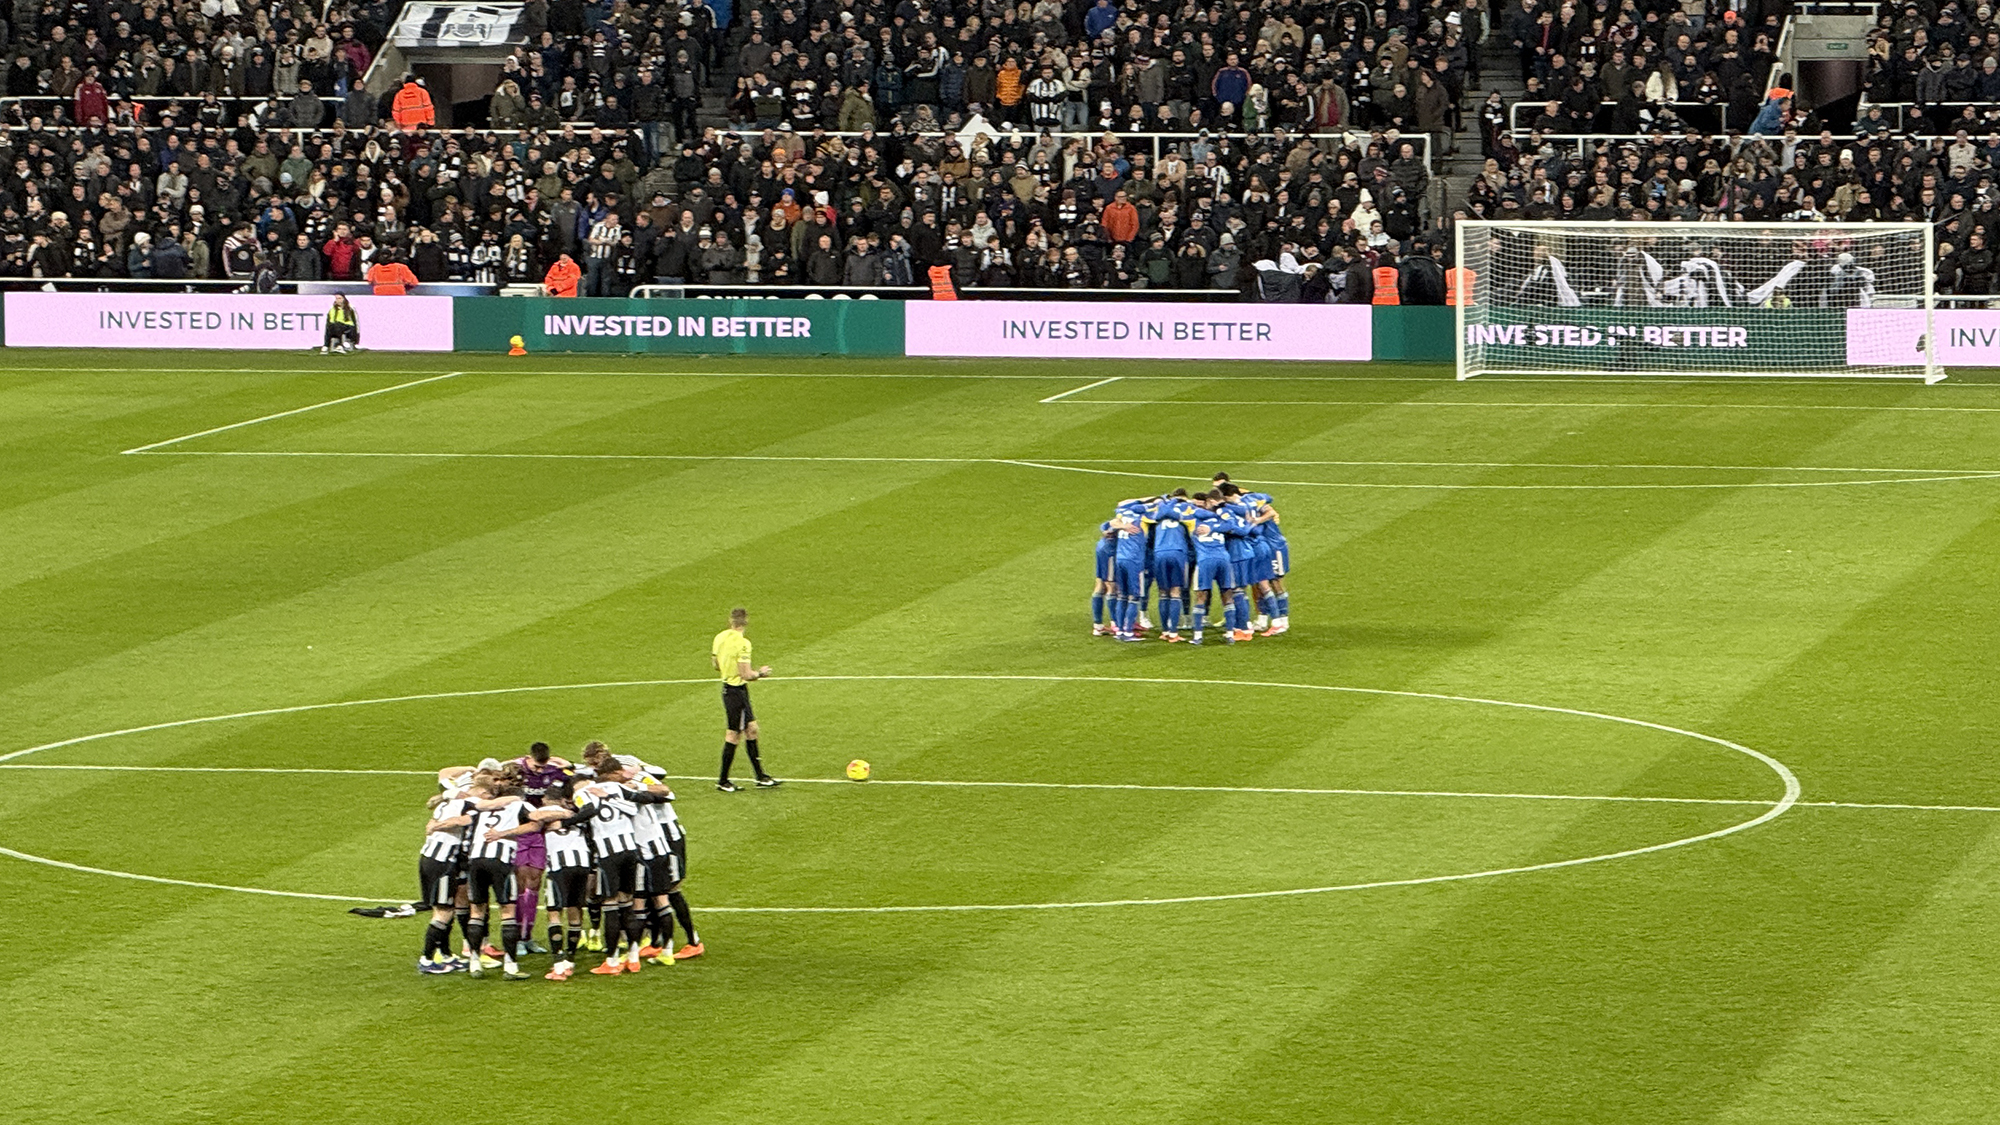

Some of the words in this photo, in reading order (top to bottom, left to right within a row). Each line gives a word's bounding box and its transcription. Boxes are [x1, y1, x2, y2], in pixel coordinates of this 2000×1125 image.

[99, 311, 222, 330] INVESTED
[230, 312, 254, 330] IN
[263, 313, 324, 331] BETT
[544, 315, 673, 336] INVESTED
[678, 316, 705, 336] IN
[712, 317, 811, 338] BETTER
[1002, 320, 1130, 340] INVESTED
[1139, 321, 1163, 341] IN
[1174, 322, 1272, 342] BETTER
[1467, 324, 1602, 346] INVESTED
[1643, 326, 1748, 347] BETTER
[1950, 328, 2000, 347] INV
